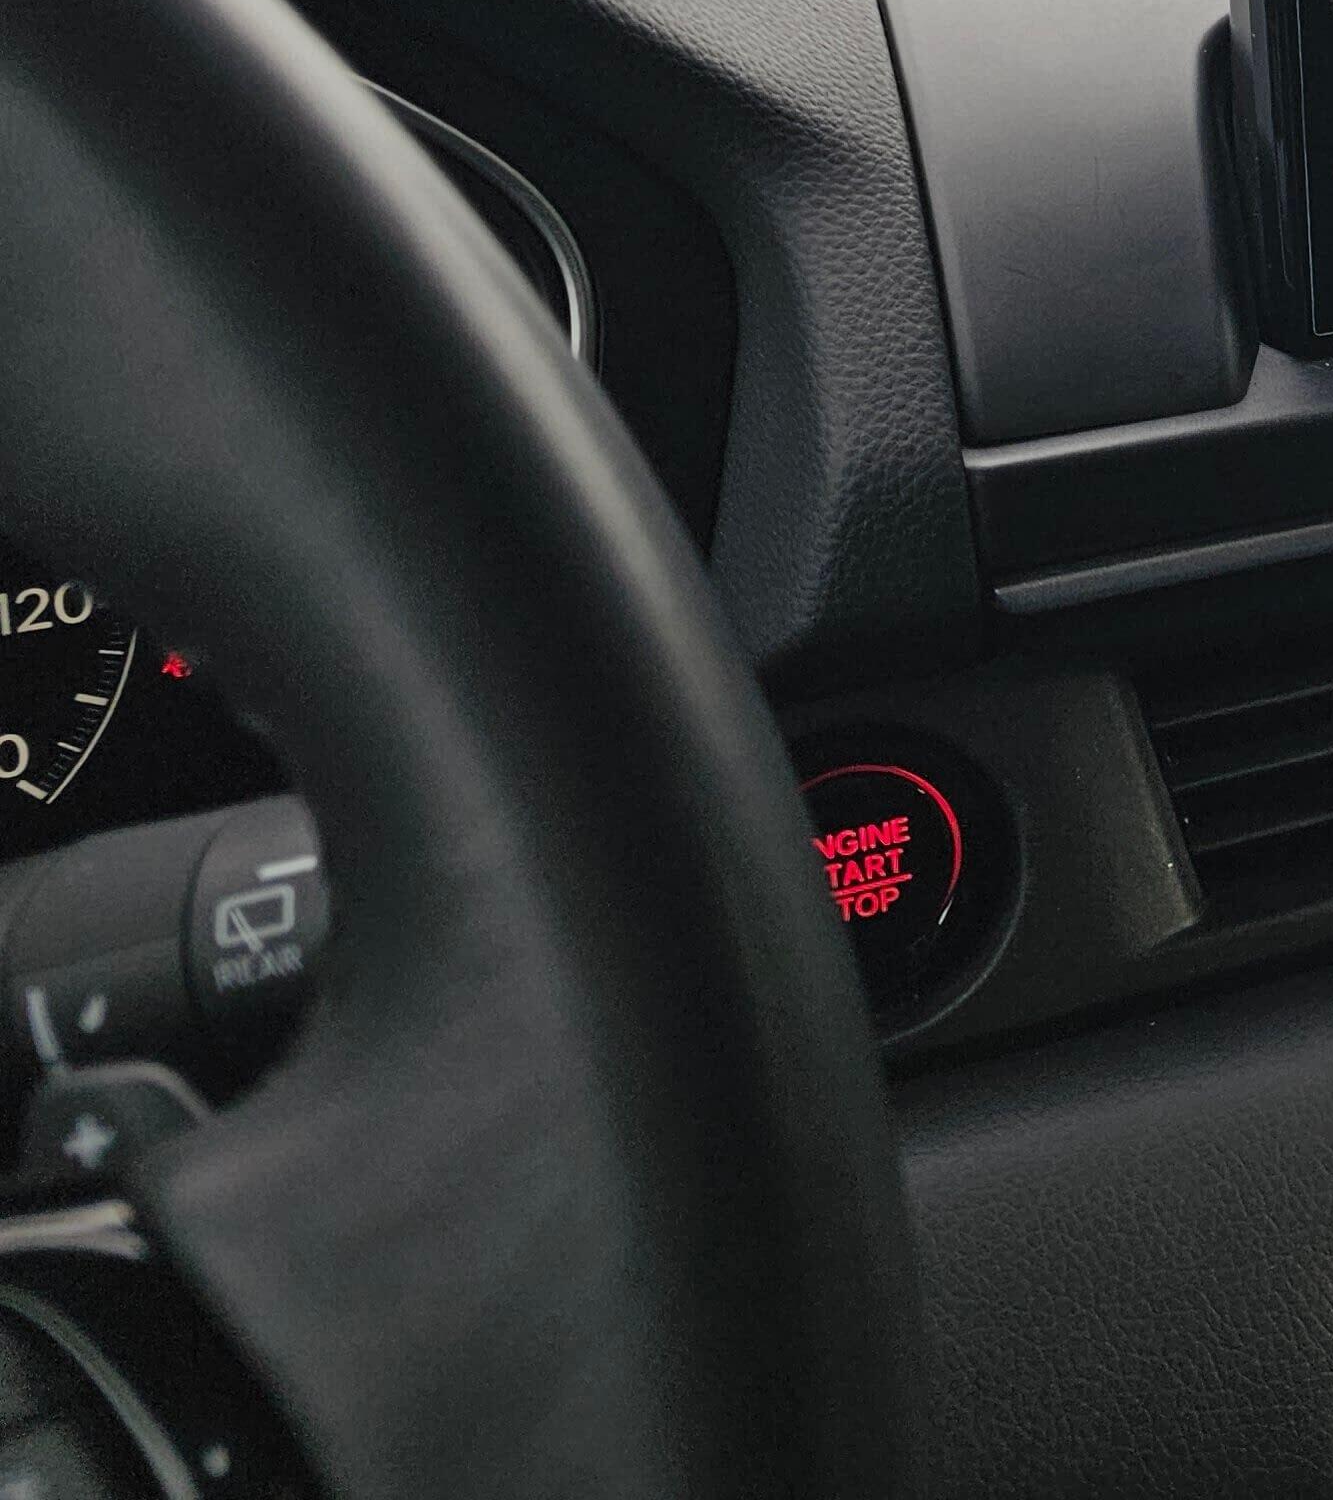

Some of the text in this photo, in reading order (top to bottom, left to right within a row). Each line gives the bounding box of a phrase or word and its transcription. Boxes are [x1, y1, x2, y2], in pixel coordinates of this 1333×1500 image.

[811, 816, 911, 859] NGINE
[824, 847, 904, 888] TART
[835, 887, 900, 922] TOP
